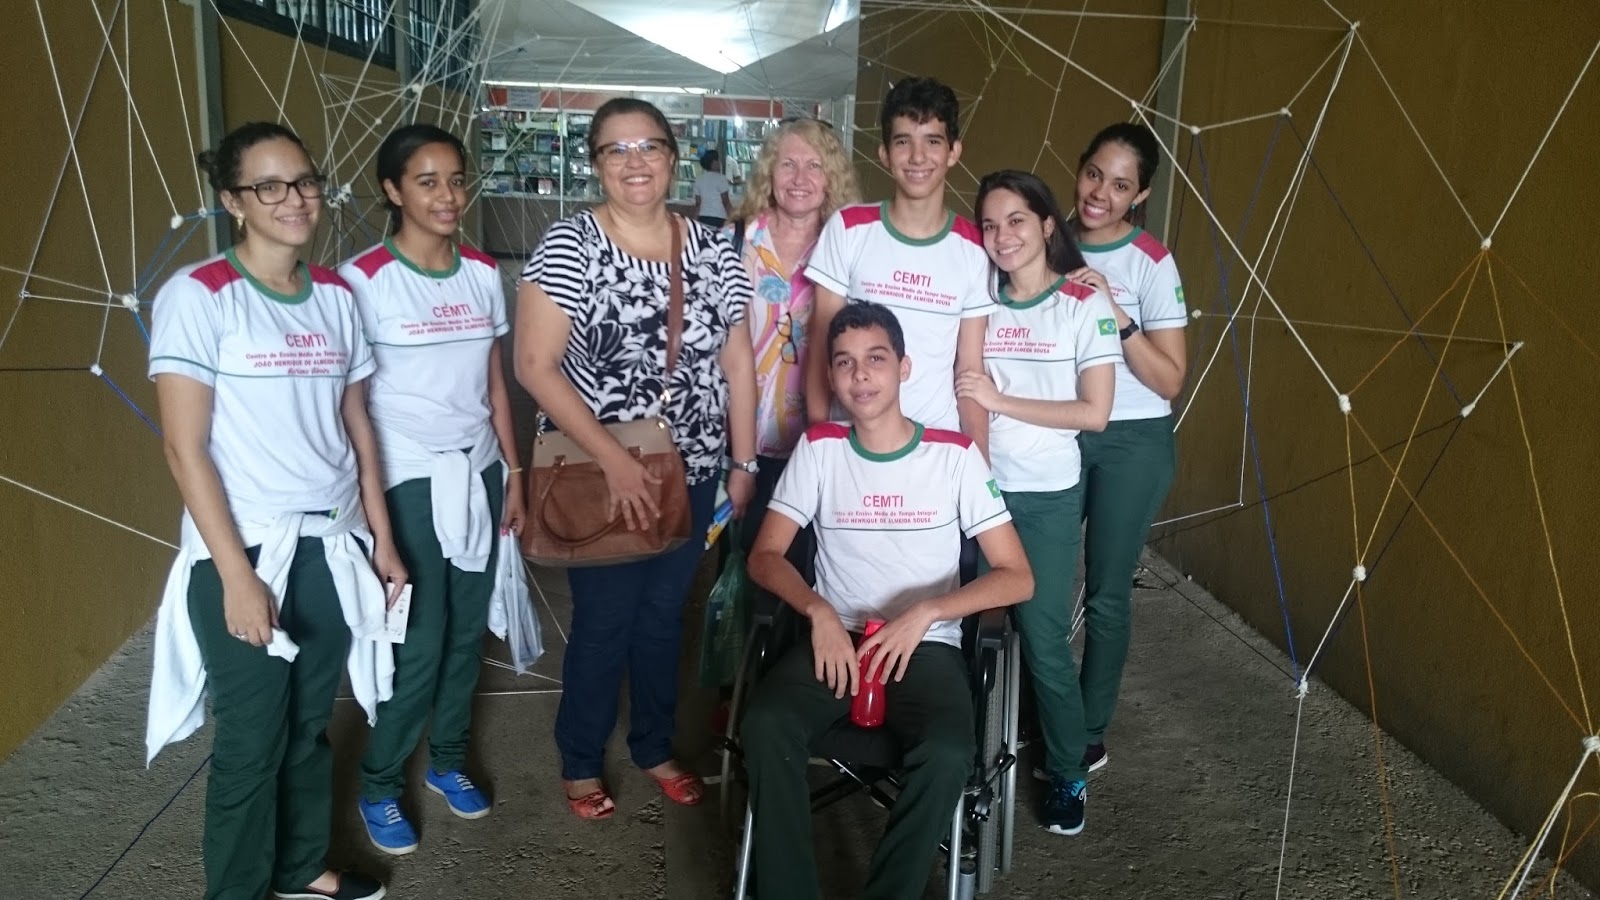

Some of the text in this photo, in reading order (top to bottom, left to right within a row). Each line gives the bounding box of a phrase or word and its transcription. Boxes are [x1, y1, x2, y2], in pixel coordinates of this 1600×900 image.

[893, 270, 932, 287] CEMTI
[879, 290, 904, 298] HENRIQUE
[913, 295, 934, 303] ALMEIDA
[936, 298, 951, 306] SOUSA
[940, 292, 957, 300] Integral
[432, 304, 472, 318] CEMTI
[996, 328, 1030, 338] CEMTI
[285, 333, 327, 347] CEMTI
[254, 360, 272, 368] JOÃO
[863, 495, 904, 507] CEMTI
